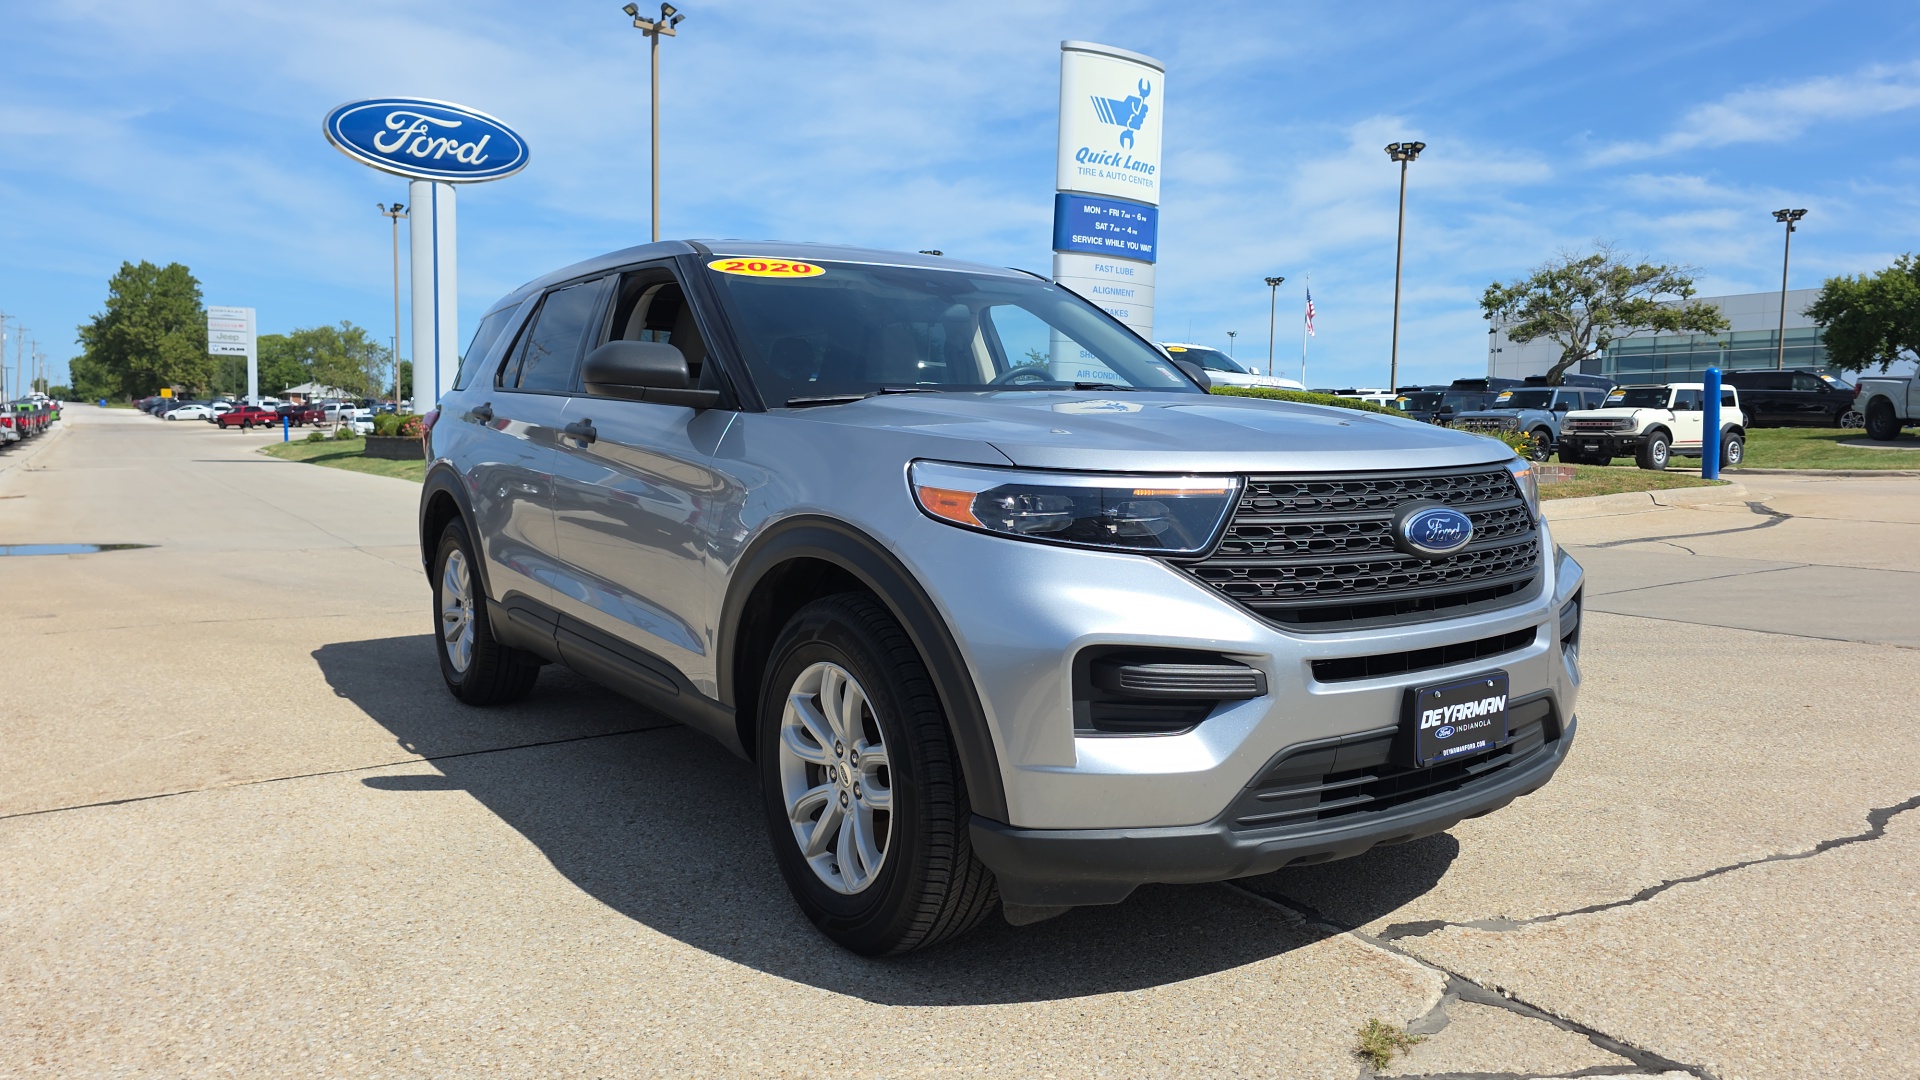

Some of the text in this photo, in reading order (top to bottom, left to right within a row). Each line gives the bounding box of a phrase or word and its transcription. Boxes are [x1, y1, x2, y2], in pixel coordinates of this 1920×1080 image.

[373, 110, 491, 165] Ford
[1075, 147, 1155, 175] Quick Lane
[1077, 167, 1154, 188] TIRE & AUTO CENTER
[1083, 205, 1101, 214] MON
[1108, 208, 1120, 217] FRI
[1095, 221, 1108, 231] SAT
[1072, 234, 1152, 253] SERVICE WHILE YOU WAIT
[725, 261, 811, 274] 2020
[1094, 264, 1134, 276] FAST LUBE
[1092, 285, 1135, 298] ALIGNMENT
[1103, 307, 1129, 318] RAKES
[1077, 370, 1090, 378] AIR
[1425, 517, 1462, 543] Ford
[1420, 694, 1507, 730] DEYARMAN
[1456, 718, 1492, 733] INDIANOLA
